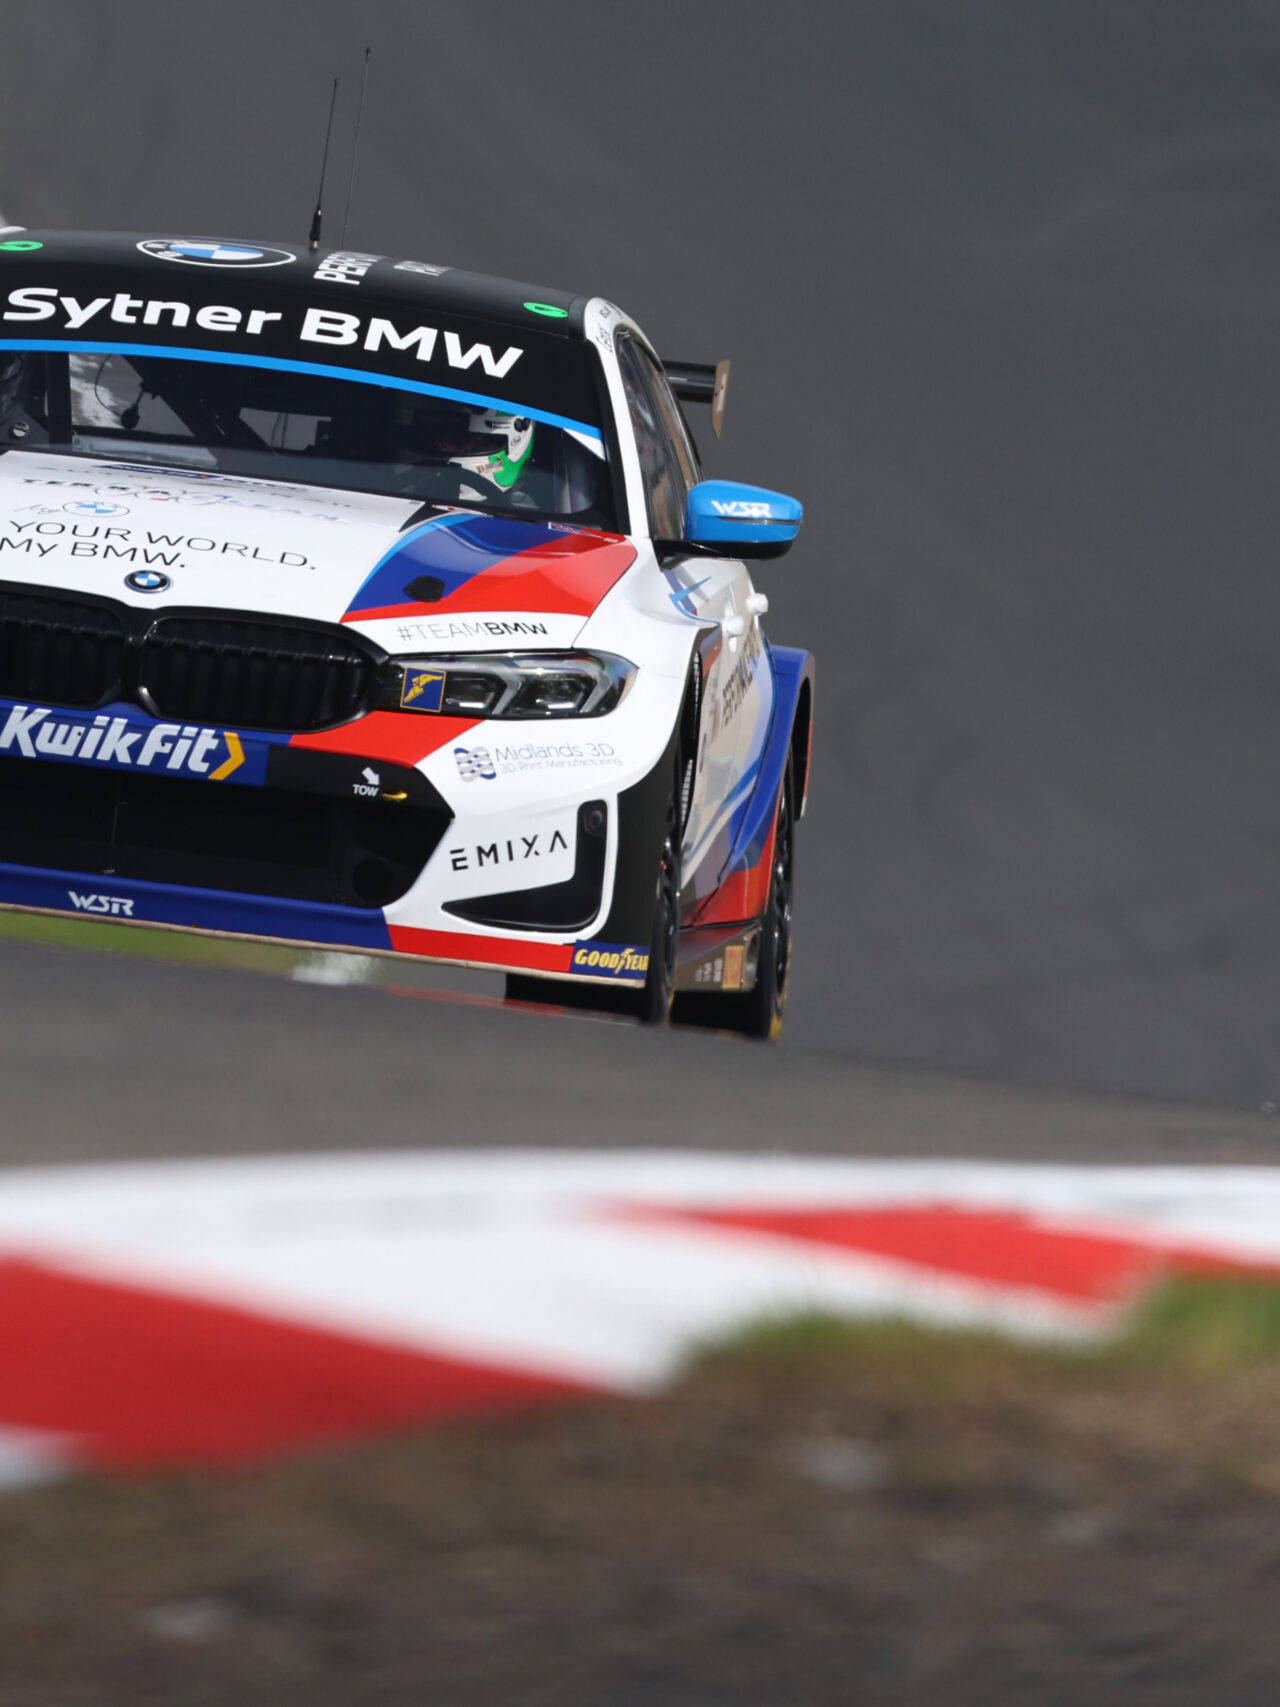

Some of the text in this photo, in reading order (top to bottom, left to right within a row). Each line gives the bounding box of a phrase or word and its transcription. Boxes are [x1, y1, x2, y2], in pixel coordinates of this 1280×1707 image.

[3, 287, 524, 379] Sytner BMW
[711, 500, 772, 518] WSR
[9, 520, 317, 570] YOUR WORLD.
[70, 542, 186, 568] BMW.
[397, 621, 549, 641] #TEAMBMW
[495, 743, 615, 763] Midlands 3D
[352, 784, 380, 797] TOW
[449, 830, 568, 871] EMIXA
[67, 890, 134, 917] WSR
